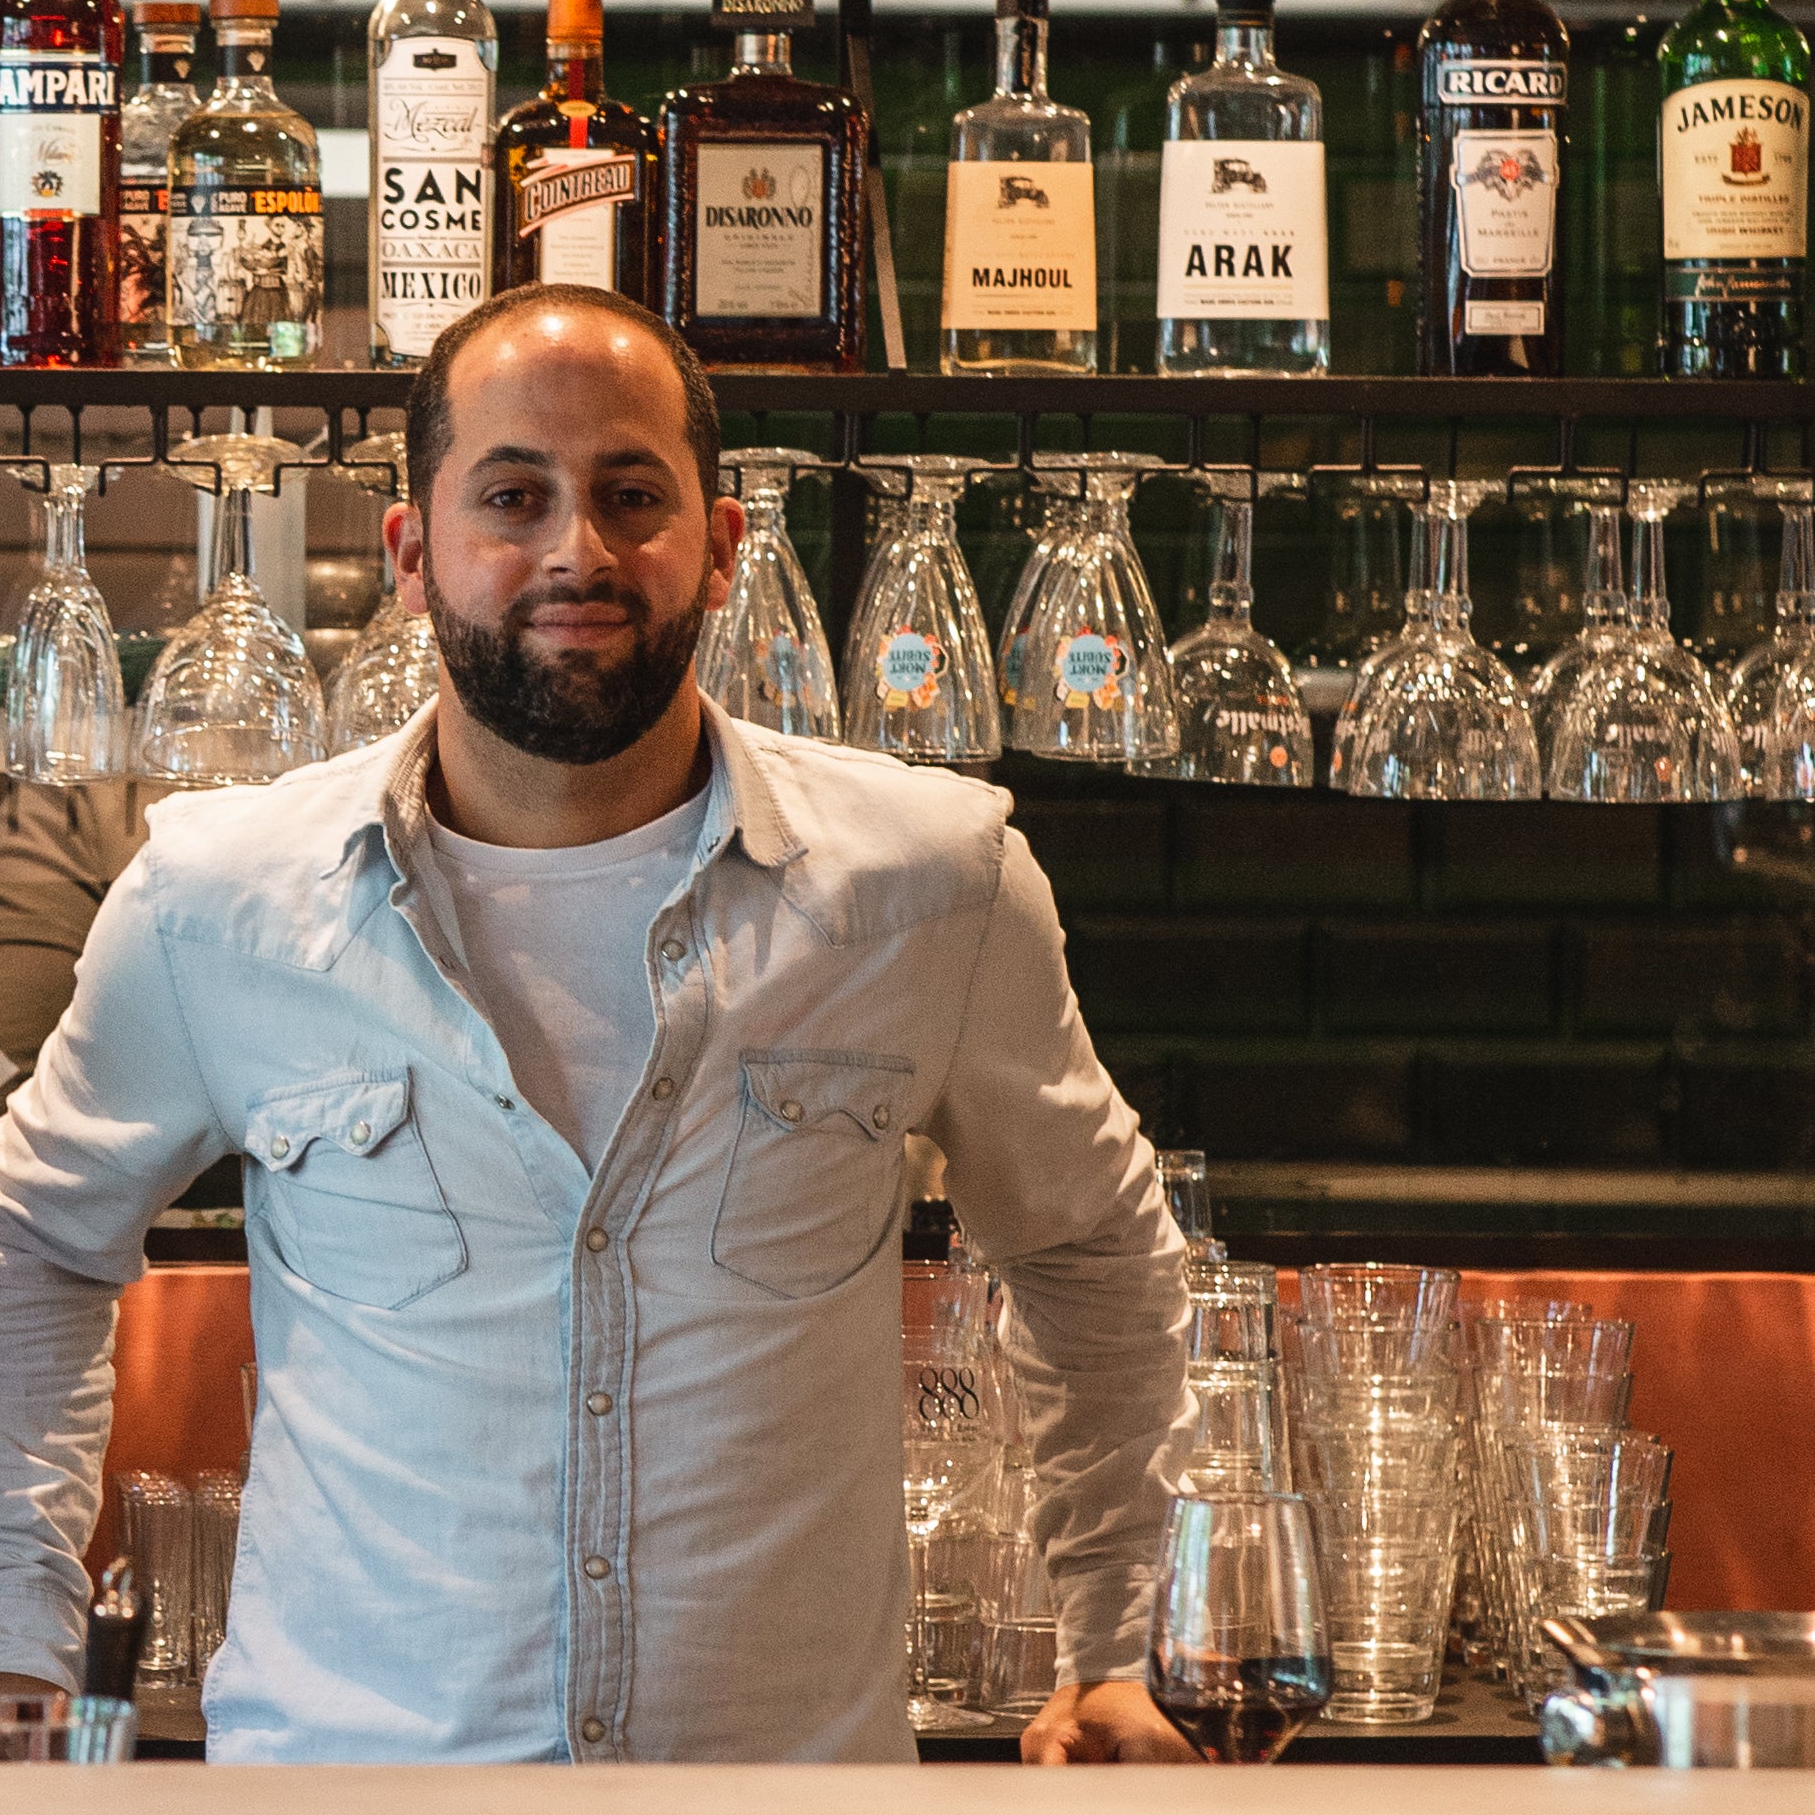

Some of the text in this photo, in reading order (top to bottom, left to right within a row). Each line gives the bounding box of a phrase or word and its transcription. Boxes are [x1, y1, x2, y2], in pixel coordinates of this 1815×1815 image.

[1449, 71, 1563, 95] RICARD
[1677, 94, 1803, 133] JAMESON
[385, 167, 482, 204] SAN
[524, 163, 631, 223] COINTREAU
[381, 209, 482, 231] COSME
[705, 206, 813, 230] DISARONNO
[381, 242, 481, 259] OAXACA
[1184, 244, 1293, 277] ARAK
[381, 271, 482, 300] MEXICO
[972, 267, 1074, 289] MAJHOUL
[890, 662, 926, 675] MORT
[1071, 664, 1106, 676] MORT
[919, 1367, 980, 1420] 888
